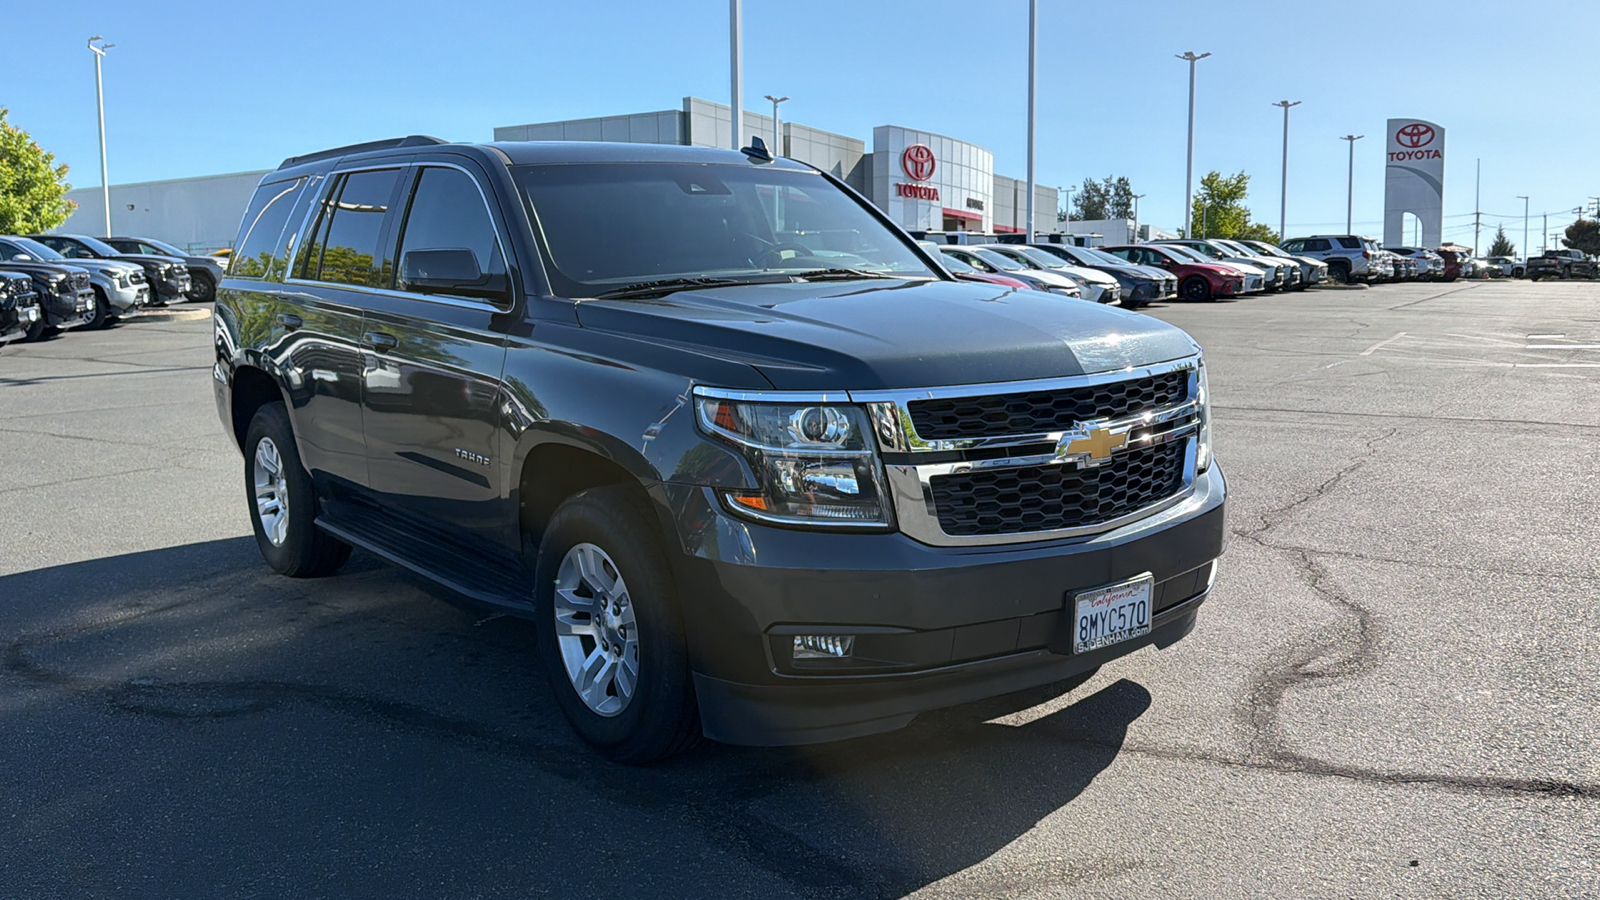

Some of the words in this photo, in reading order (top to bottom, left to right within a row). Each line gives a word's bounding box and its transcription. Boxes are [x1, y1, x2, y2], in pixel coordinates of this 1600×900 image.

[1388, 149, 1442, 161] TOYOTA
[896, 182, 940, 201] TOYOTA
[454, 448, 491, 468] TAHOE
[1090, 589, 1137, 608] California
[1079, 600, 1146, 641] 8MYC570
